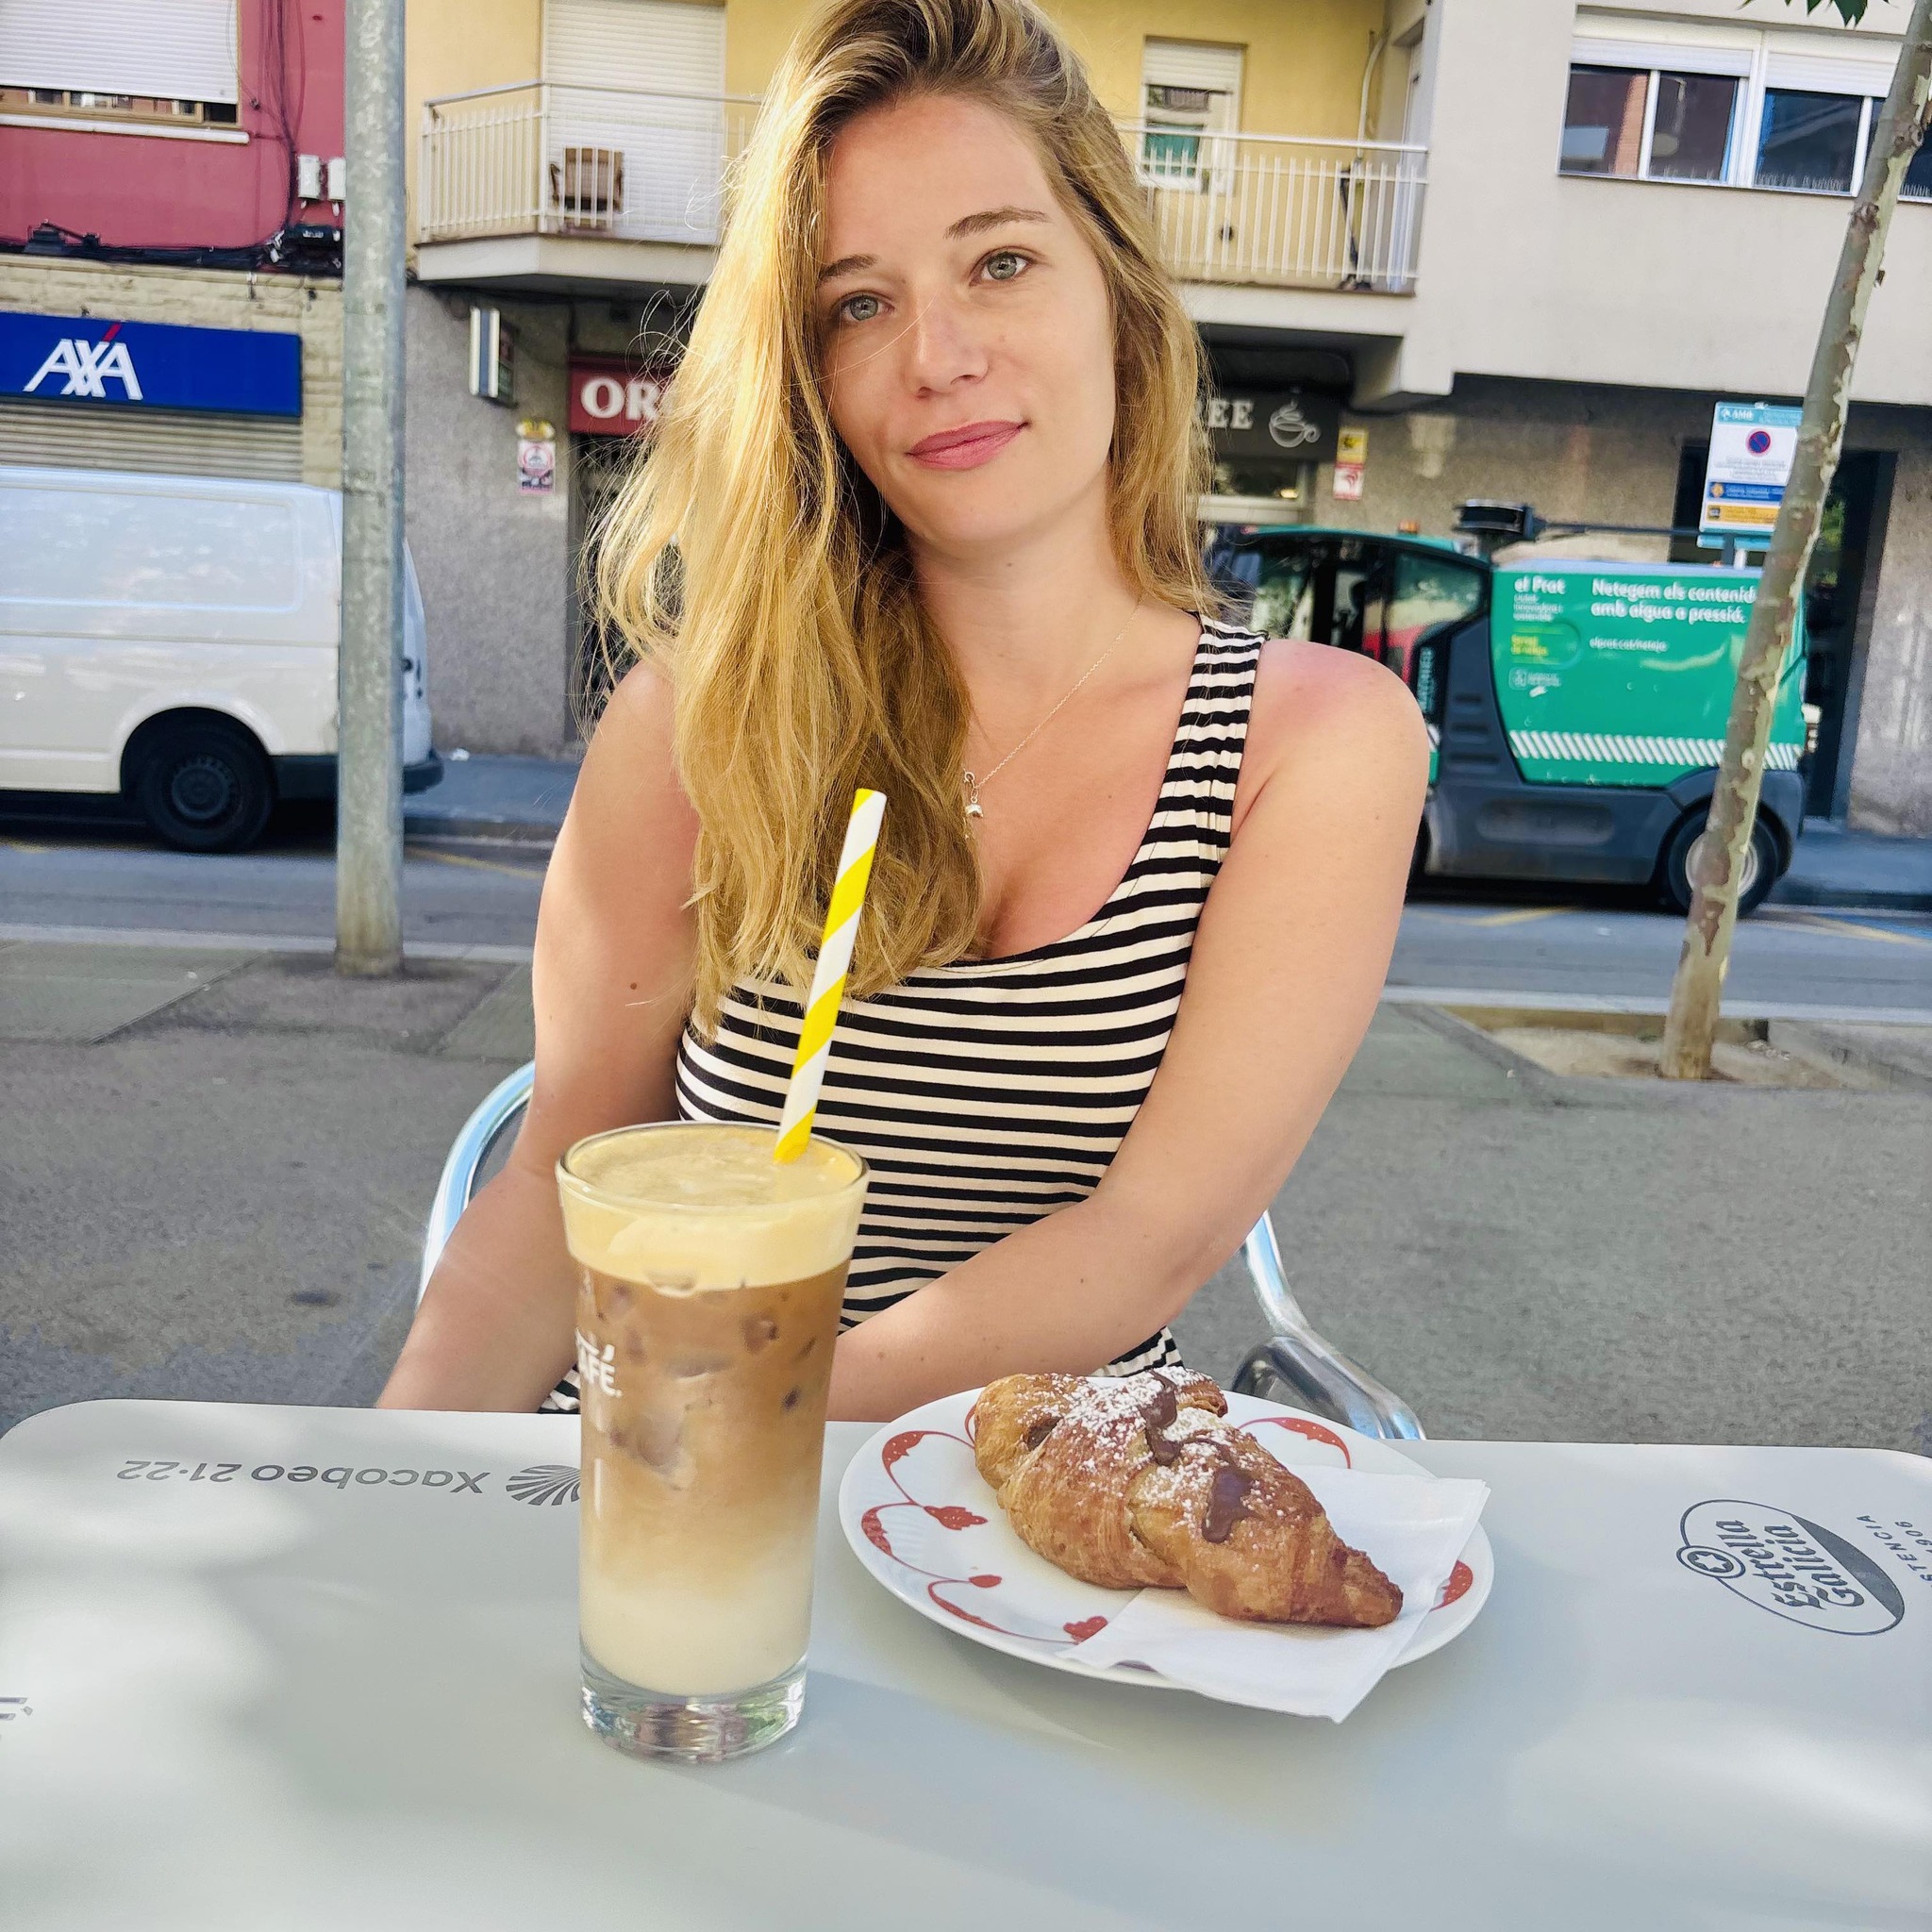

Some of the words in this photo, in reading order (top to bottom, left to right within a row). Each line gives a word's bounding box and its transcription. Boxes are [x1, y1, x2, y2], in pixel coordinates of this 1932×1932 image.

[23, 335, 142, 400] AXA
[580, 378, 662, 421] OR
[1205, 399, 1254, 430] EE
[1514, 575, 1530, 593] el
[1532, 575, 1566, 595] Prat
[1591, 577, 1661, 602] Netegem
[1663, 581, 1686, 601] els
[1688, 585, 1757, 604] contenid
[1591, 599, 1628, 618] amb
[1629, 601, 1674, 624] aigua
[1674, 607, 1687, 621] a
[251, 1463, 491, 1494] Xacobeo
[1715, 1519, 1826, 1610] Estrella
[1764, 1524, 1865, 1607] Galicia
